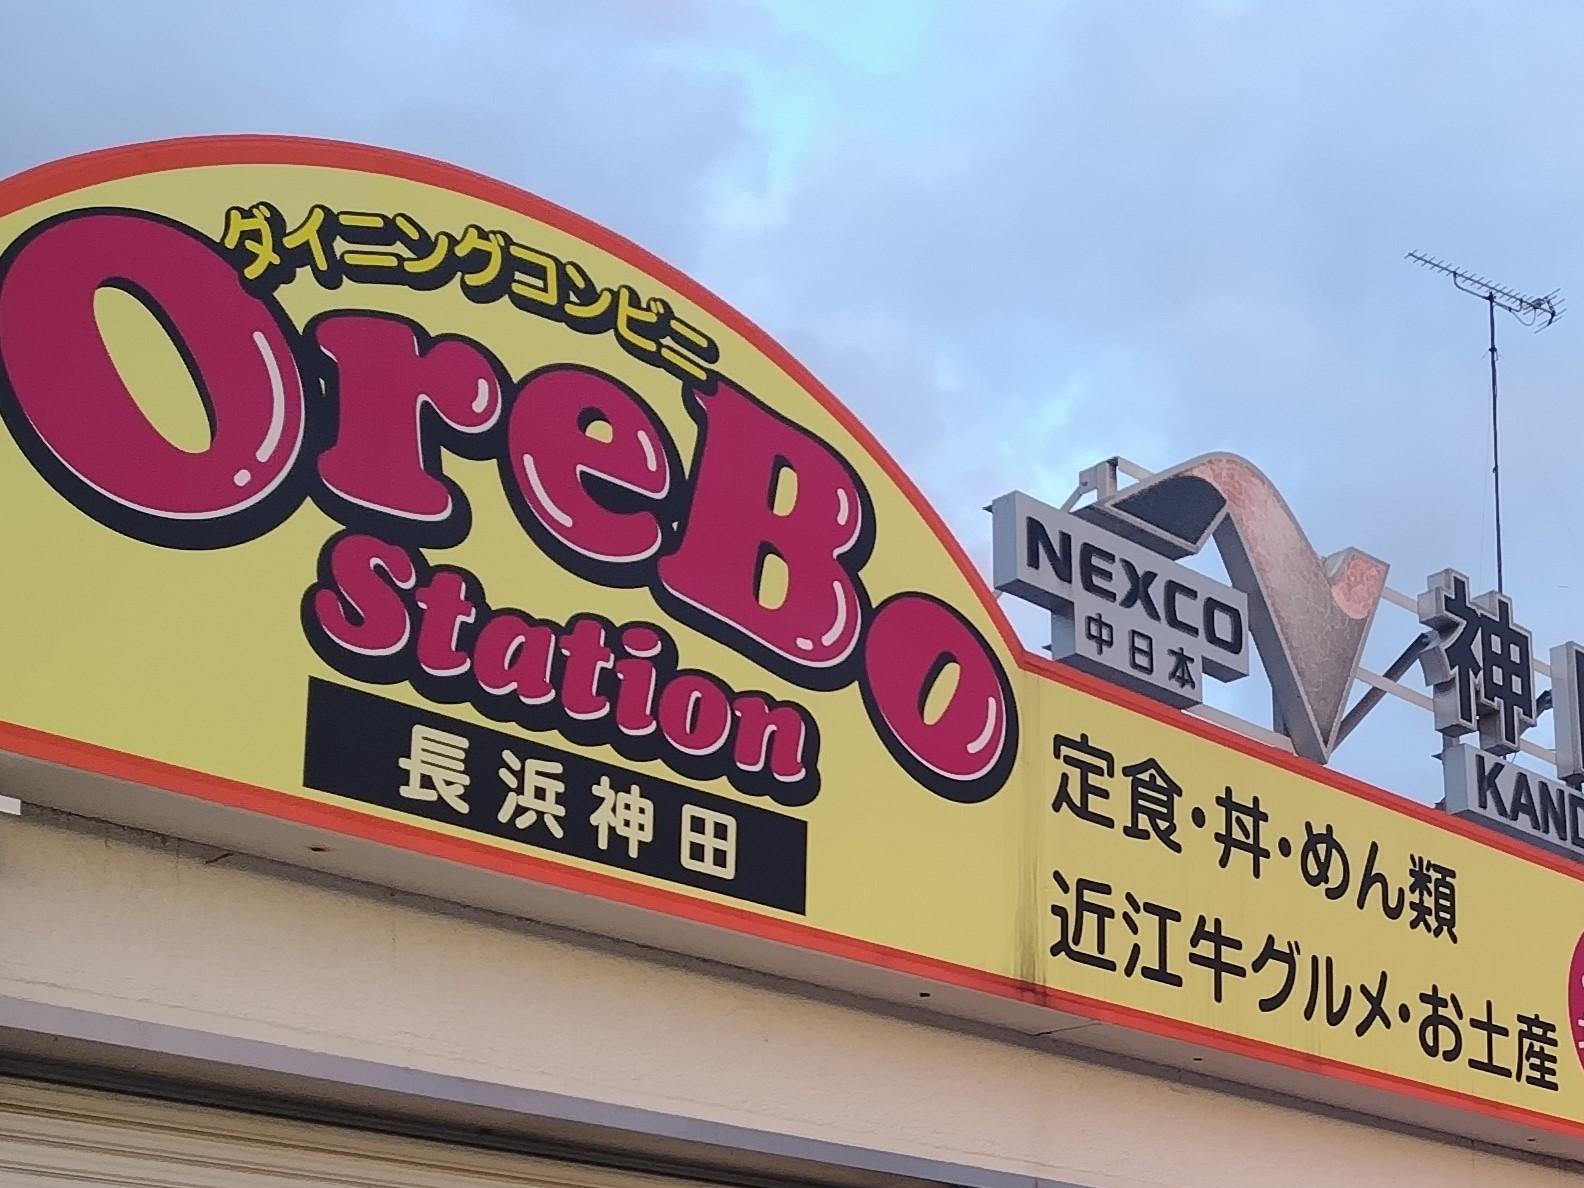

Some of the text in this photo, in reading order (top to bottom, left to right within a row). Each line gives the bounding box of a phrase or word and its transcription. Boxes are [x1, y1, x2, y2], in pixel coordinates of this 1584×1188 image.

[222, 203, 720, 383] ダイニングコンビニ
[0, 207, 1016, 800] OreBo
[1025, 516, 1243, 656] NEXCO
[302, 526, 818, 803] Station
[1084, 613, 1197, 691] 中日本
[398, 723, 738, 881] 長浜神田
[1052, 732, 1459, 945] 定食・丼・めん類
[1050, 869, 1560, 1092] 近江牛グルメ・お土産
